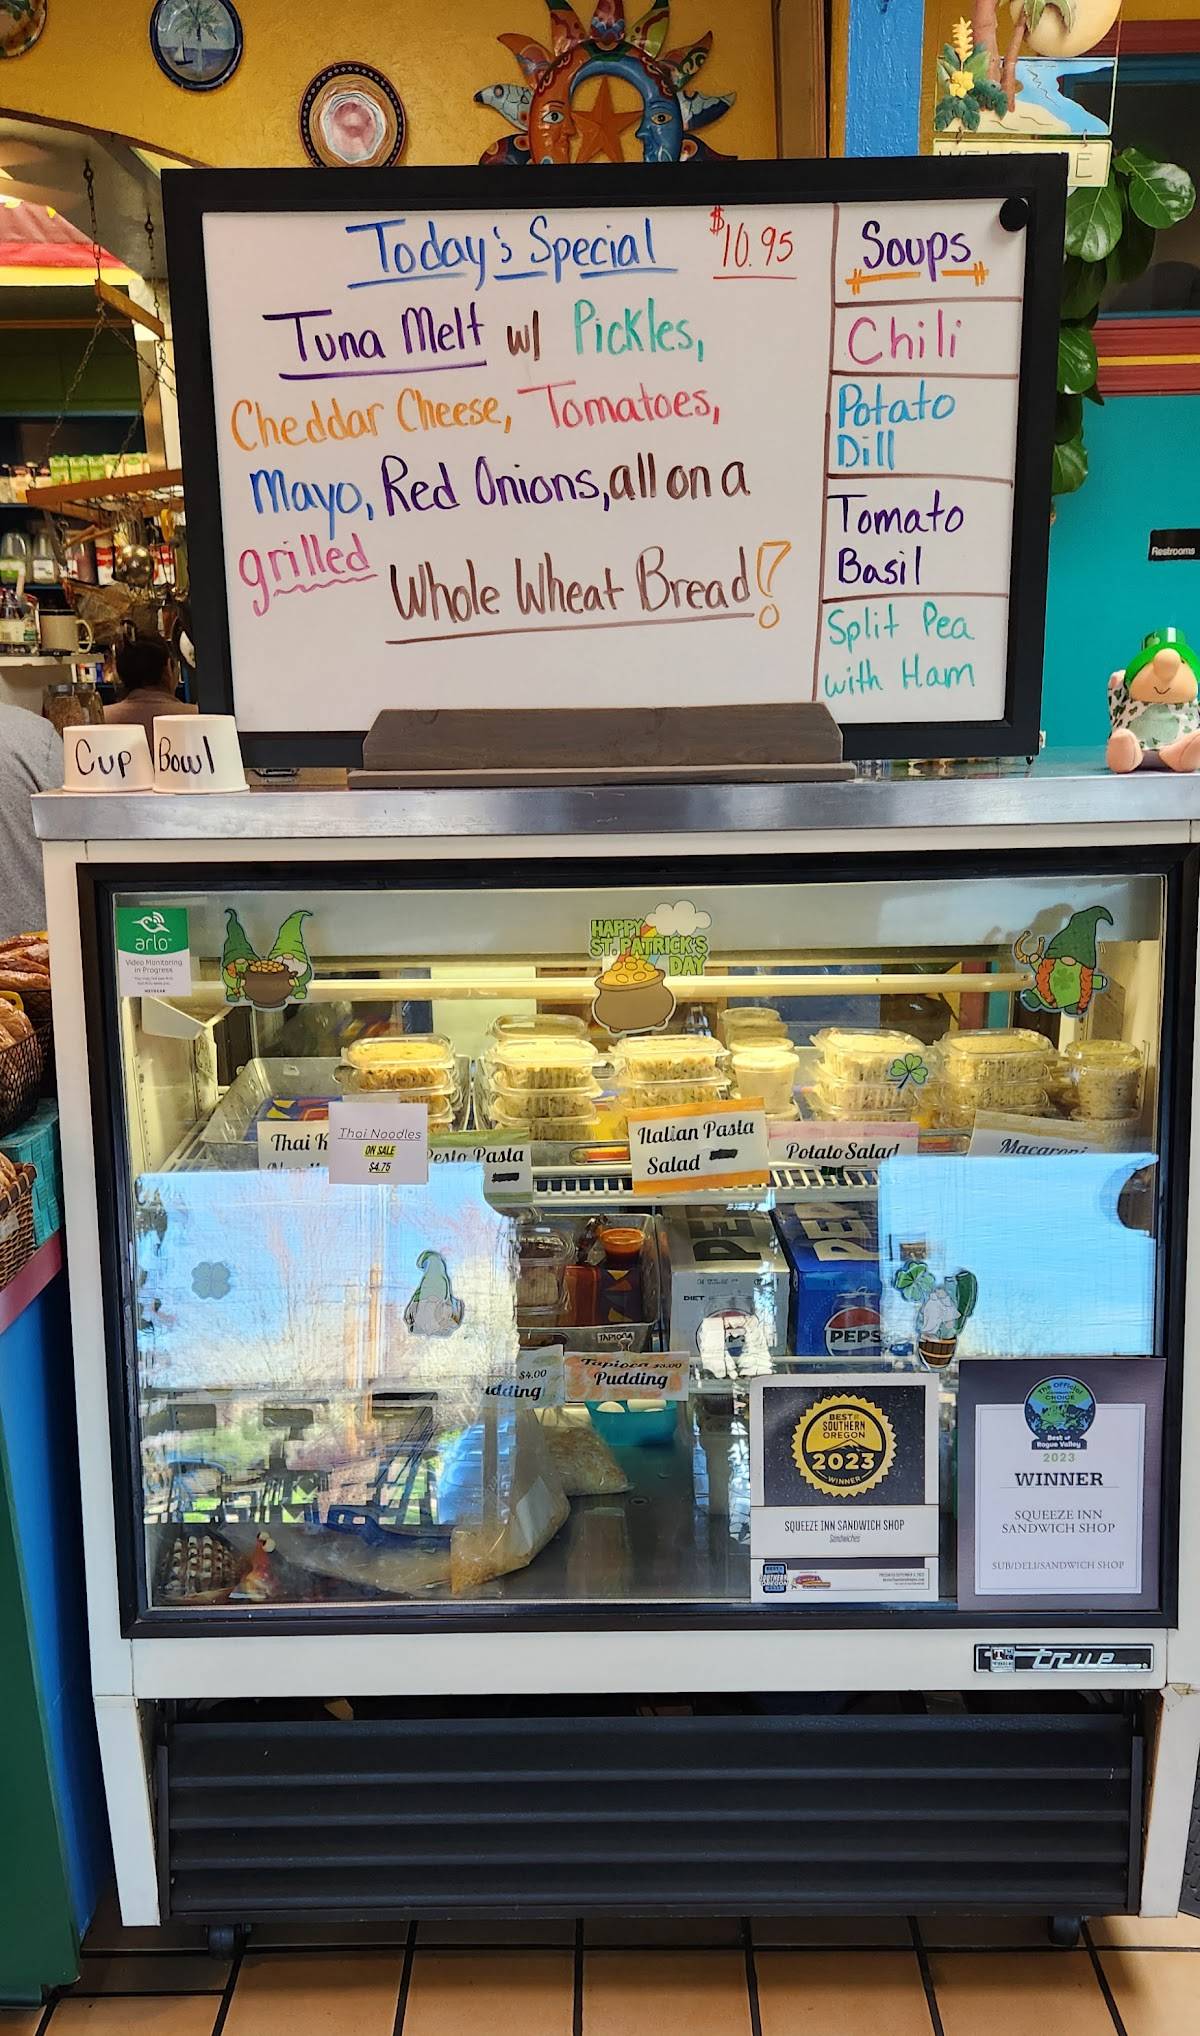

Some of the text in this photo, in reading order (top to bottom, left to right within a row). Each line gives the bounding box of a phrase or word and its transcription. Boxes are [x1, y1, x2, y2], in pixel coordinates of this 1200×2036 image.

[709, 204, 794, 268] $10.95
[345, 215, 657, 291] Today's Special
[861, 220, 972, 282] Soups
[262, 309, 386, 362] Tuna
[401, 302, 485, 354] Melt
[574, 298, 705, 362] Pickles,
[848, 308, 962, 366] Chili
[838, 379, 956, 428] Potato
[230, 380, 720, 451] Cheddar Cheese, Tomatoes,
[837, 429, 895, 471] Dill
[250, 452, 751, 541] Mayo, Red Onions, all on a
[826, 489, 964, 535] Tomato
[1151, 545, 1196, 557] Restrooms
[238, 532, 371, 617] grilled
[838, 545, 922, 586] Basil
[389, 558, 501, 624] Whole
[514, 552, 625, 616] Wheat
[827, 600, 975, 653] Split Pea
[824, 653, 975, 698] with Ham
[75, 738, 132, 779] Cup
[159, 735, 215, 775] Bowl
[591, 919, 646, 938] HAPPY
[135, 934, 168, 951] arlo
[590, 935, 709, 956] ST. PATRICK'S
[146, 959, 183, 967] Monitoring
[669, 956, 706, 976] DAY
[340, 1127, 422, 1139] Thai Noodles
[637, 1119, 754, 1145] Italian Pasta
[270, 1133, 310, 1151] Thai
[365, 1145, 396, 1156] ON SALE
[786, 1142, 900, 1160] Potato Salad
[473, 1146, 524, 1163] Pasta
[369, 1161, 392, 1173] $4.75
[646, 1154, 700, 1175] Salad
[581, 1358, 649, 1369] Tapioca
[519, 1369, 547, 1380] $4.00
[594, 1372, 669, 1389] Pudding
[484, 1382, 542, 1400] udding
[1038, 1385, 1052, 1394] The
[822, 1421, 866, 1432] SOUTHERN
[822, 1431, 866, 1439] OREGON
[1037, 1441, 1081, 1449] Rogue Valley
[812, 1453, 875, 1470] 2023
[1043, 1453, 1075, 1462] 2023
[828, 1475, 862, 1485] WINNER
[1015, 1472, 1103, 1487] WINNER
[1014, 1510, 1103, 1521] SQUEEZE INN
[784, 1519, 905, 1532] SQUEEZE INN SANDWICH SHOP
[1002, 1522, 1116, 1534] SANDWICH SHOP
[1097, 1560, 1125, 1570] SHOP
